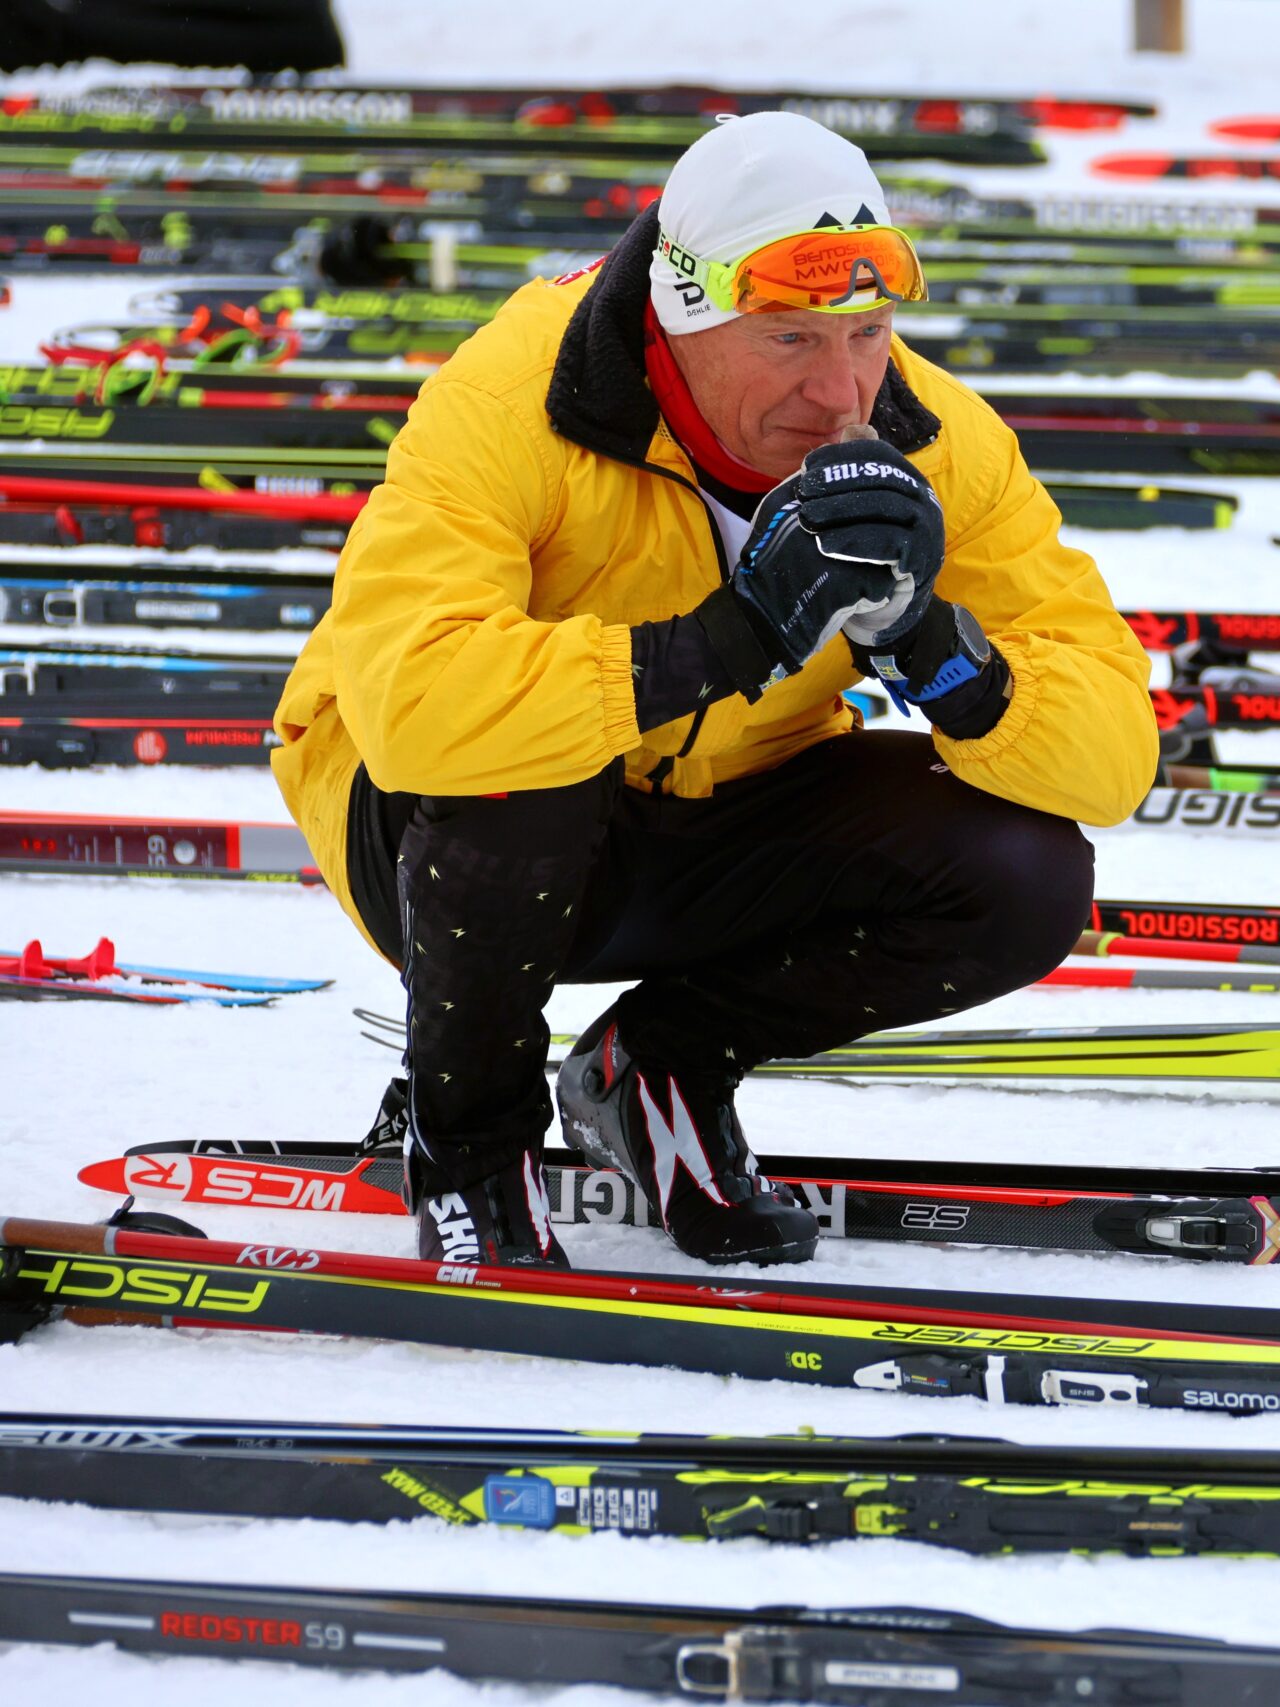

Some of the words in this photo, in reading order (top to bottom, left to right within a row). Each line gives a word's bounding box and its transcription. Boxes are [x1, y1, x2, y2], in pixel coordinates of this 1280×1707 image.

[1120, 909, 1280, 944] ROSSIGNOL
[202, 1166, 347, 1212] WCS
[900, 1203, 970, 1232] S2
[871, 1323, 1156, 1355] FISCHER
[791, 1351, 823, 1372] 3D
[160, 1610, 301, 1647] REDSTER
[304, 1621, 346, 1652] S9
